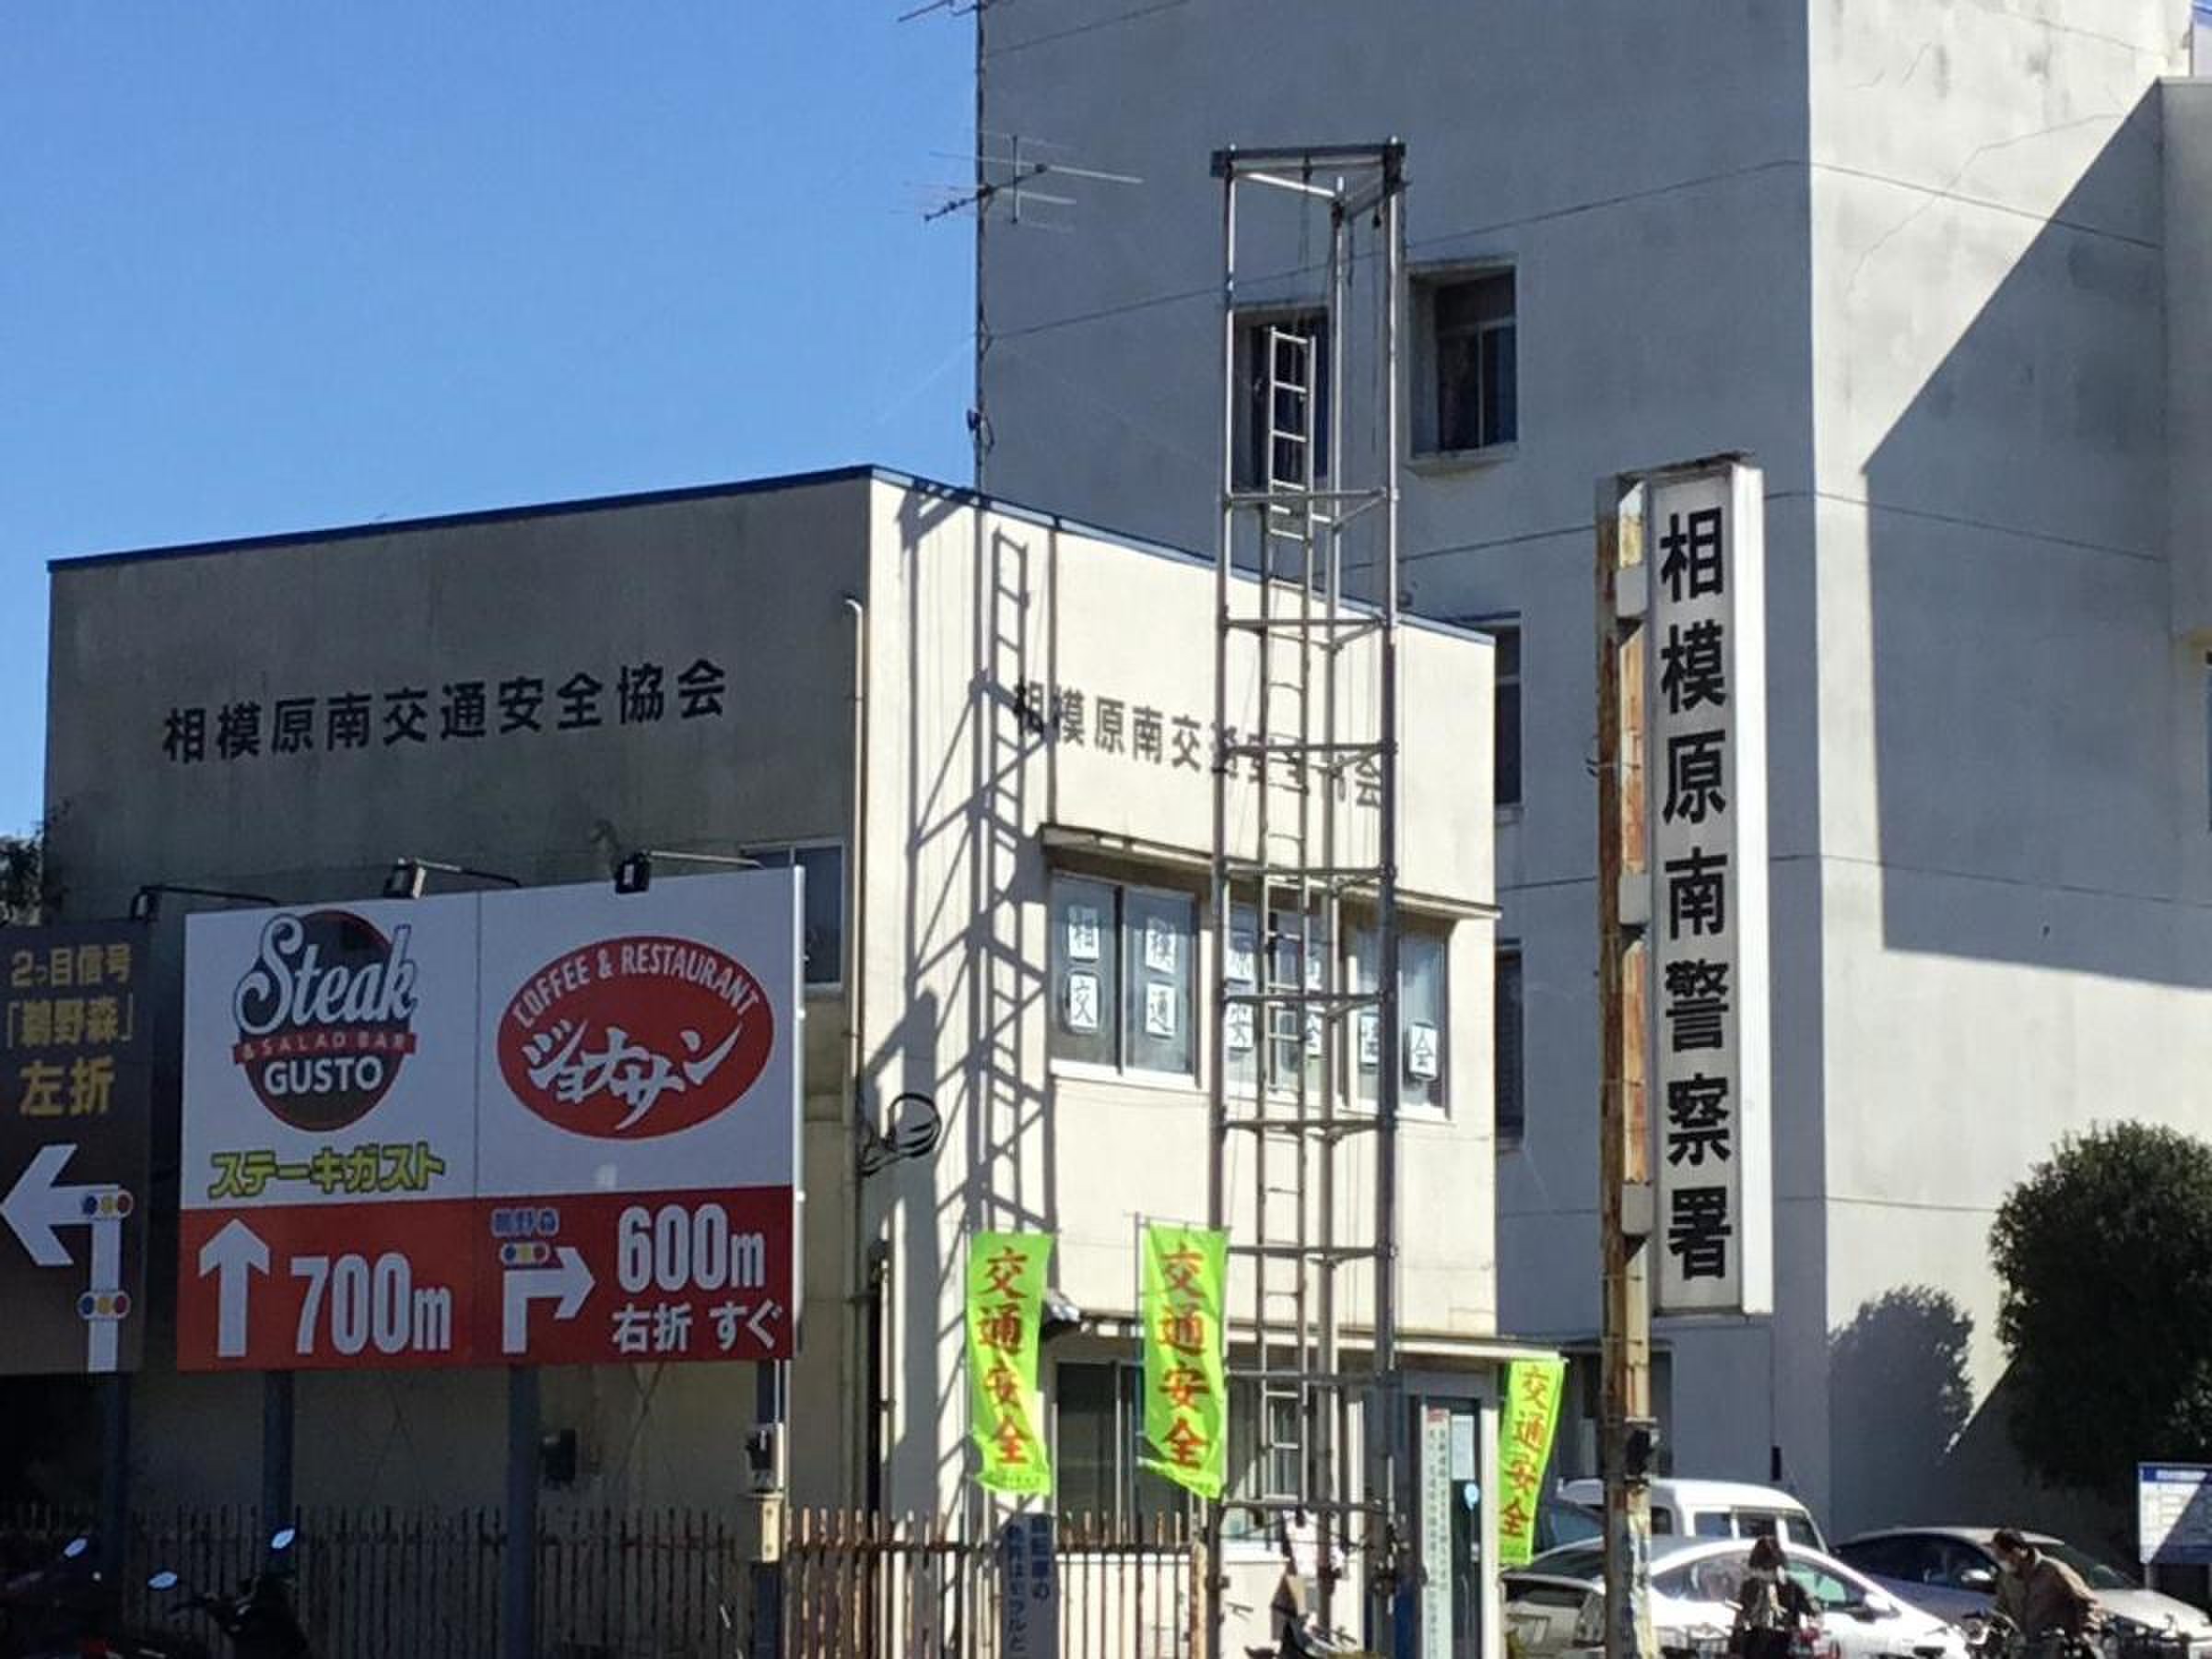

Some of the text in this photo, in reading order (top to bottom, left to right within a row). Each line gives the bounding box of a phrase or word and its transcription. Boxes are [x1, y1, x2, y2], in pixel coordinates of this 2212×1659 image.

[162, 658, 726, 764] 相模原南交通安全協会
[1014, 680, 1383, 808] 相模原南交会
[1659, 506, 1733, 1281] 相模原南警察署
[234, 913, 418, 1035] Steak
[512, 943, 759, 1029] COFFEE & RESTAURANT
[18, 1054, 116, 1116] 左折
[265, 1055, 384, 1096] GUSTO
[522, 1018, 744, 1130] ジョナサン
[208, 1141, 446, 1200] ステーキガスト
[618, 1202, 766, 1292] 600m
[289, 1252, 452, 1356] 700m
[611, 1298, 782, 1354] 右折 すぐ
[977, 1245, 1032, 1465] 交通安全
[1157, 1241, 1211, 1470] 交通安全
[1500, 1365, 1549, 1539] 交通安全
